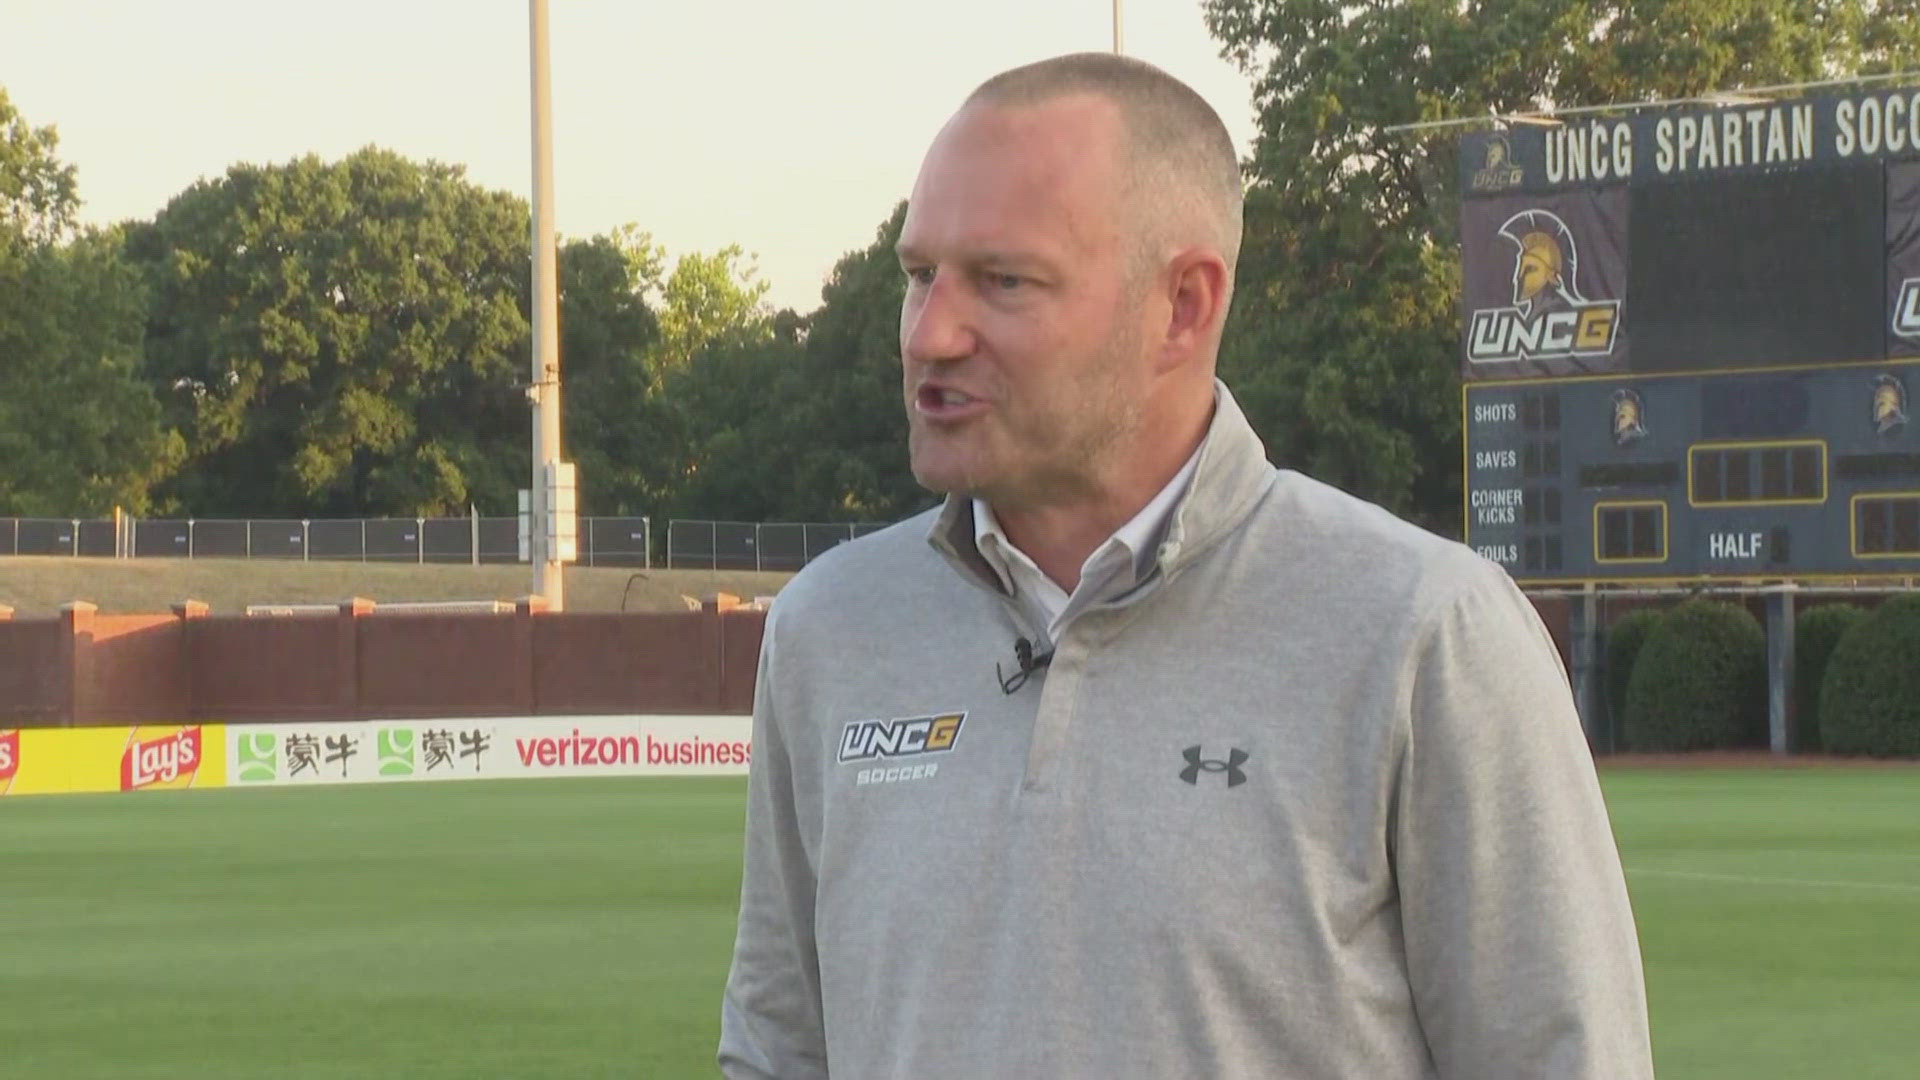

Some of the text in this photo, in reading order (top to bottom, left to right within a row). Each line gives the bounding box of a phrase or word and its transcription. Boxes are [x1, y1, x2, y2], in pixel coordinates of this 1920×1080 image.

[1545, 122, 1633, 184] UNCG
[1655, 106, 1813, 173] SPARTAN
[1473, 168, 1524, 188] UNCG
[1472, 309, 1614, 357] UNCG
[1474, 403, 1517, 422] SHOTS
[1476, 450, 1517, 469] SAVES
[1471, 489, 1523, 507] CORNER
[1478, 507, 1516, 524] KICKS
[1477, 545, 1518, 562] FOULS
[1709, 532, 1763, 558] HALF
[422, 728, 492, 772] 蒙牛
[516, 729, 639, 767] verizon
[841, 715, 964, 759] UNCG
[132, 732, 193, 786] Lay's
[285, 733, 359, 777] 蒙牛
[857, 763, 938, 786] SOCCER
